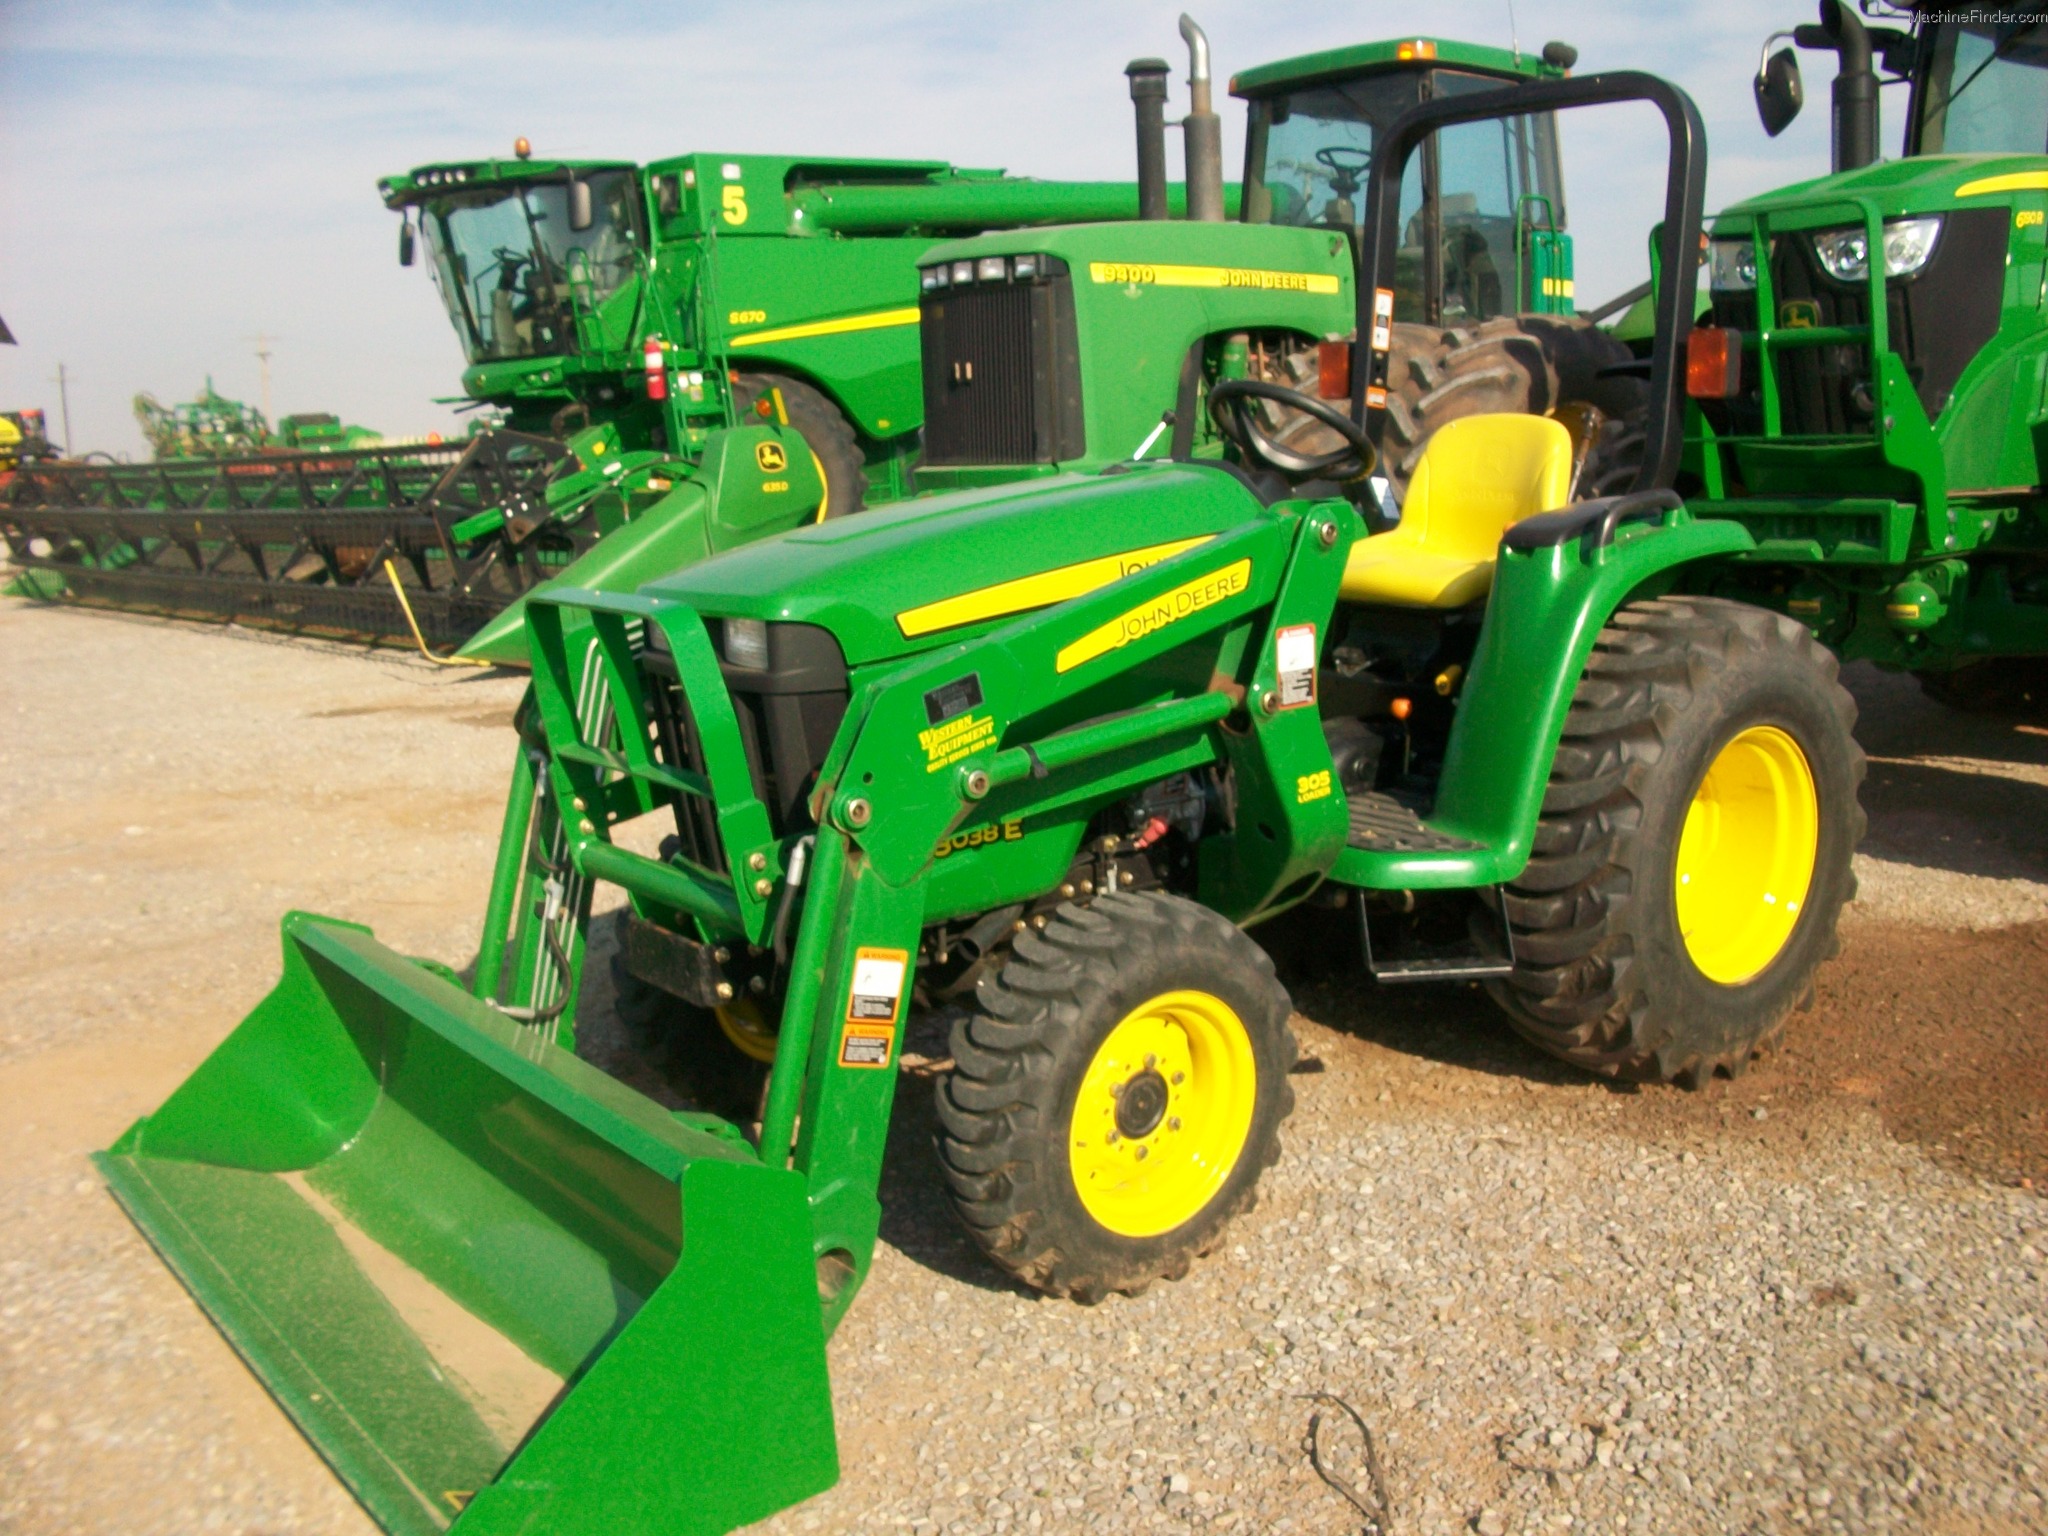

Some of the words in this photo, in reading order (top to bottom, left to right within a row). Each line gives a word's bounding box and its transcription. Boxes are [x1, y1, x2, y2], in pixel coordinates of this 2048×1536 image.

[722, 185, 748, 226] 5
[1103, 264, 1156, 283] 9400
[1220, 269, 1263, 289] JOHN
[1264, 273, 1308, 291] DEERE
[729, 309, 767, 326] S670
[1116, 603, 1172, 644] JOHN
[1175, 571, 1243, 614] DEERE
[918, 713, 973, 751] WESTERN
[928, 720, 994, 762] EQUIPMENT
[1297, 769, 1331, 794] 305
[1297, 785, 1331, 804] LOADER
